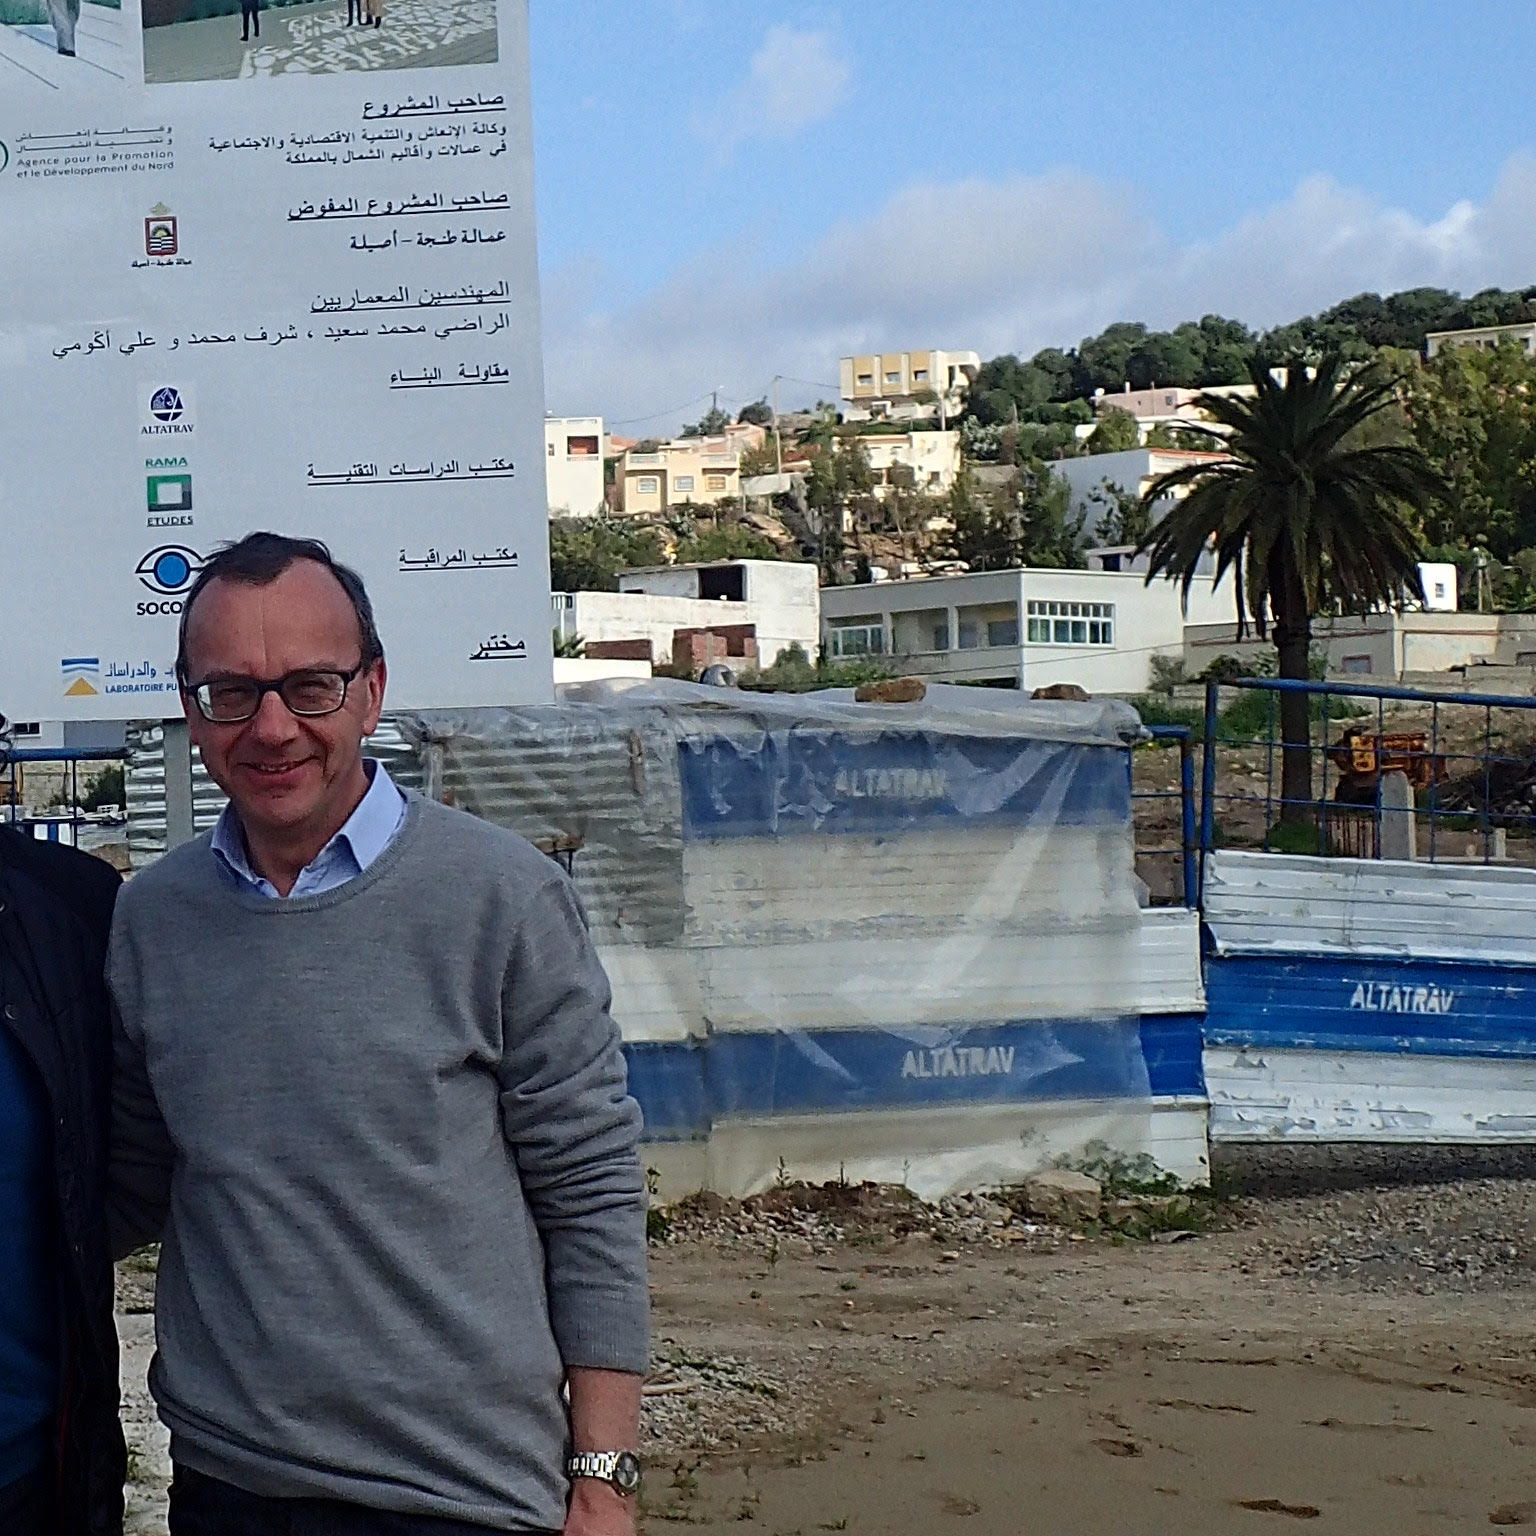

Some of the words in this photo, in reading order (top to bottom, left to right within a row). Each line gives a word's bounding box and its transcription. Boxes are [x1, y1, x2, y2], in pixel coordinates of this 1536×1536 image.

[362, 95, 440, 116] المشروع
[447, 93, 504, 111] صاحب
[361, 128, 413, 145] والتنمية
[472, 120, 506, 137] وكالة
[437, 144, 482, 157] عمالات
[489, 139, 507, 157] في
[285, 152, 337, 165] بالمملكة
[342, 150, 384, 165] الشمال
[288, 197, 358, 217] المفوض
[367, 192, 443, 214] المشروع
[451, 191, 508, 210] صاحب
[416, 229, 458, 248] طنجة
[461, 228, 506, 243] عمالة
[311, 286, 409, 311] المعماريين
[418, 280, 509, 305] المهندسين
[243, 323, 298, 345] شرف
[324, 326, 369, 342] سعيد
[377, 323, 426, 335] محمد
[434, 312, 509, 340] الراضي
[119, 330, 156, 356] علي
[188, 333, 236, 345] محمد
[390, 367, 442, 383] البناء
[458, 363, 510, 381] مقاولة
[145, 457, 188, 468] RAMA
[389, 460, 459, 478] الدراسات
[468, 458, 514, 475] مكتب
[307, 463, 378, 481] التقنية
[147, 516, 194, 526] ETUDES
[399, 548, 466, 567] المراقبة
[473, 548, 518, 565] مكتب
[136, 601, 184, 616] SOCO
[469, 634, 525, 657] مختبر
[105, 683, 164, 694] LABORATOIRE
[1350, 983, 1454, 1013] ALTATRAV
[902, 1046, 1014, 1078] ALTATRAV
